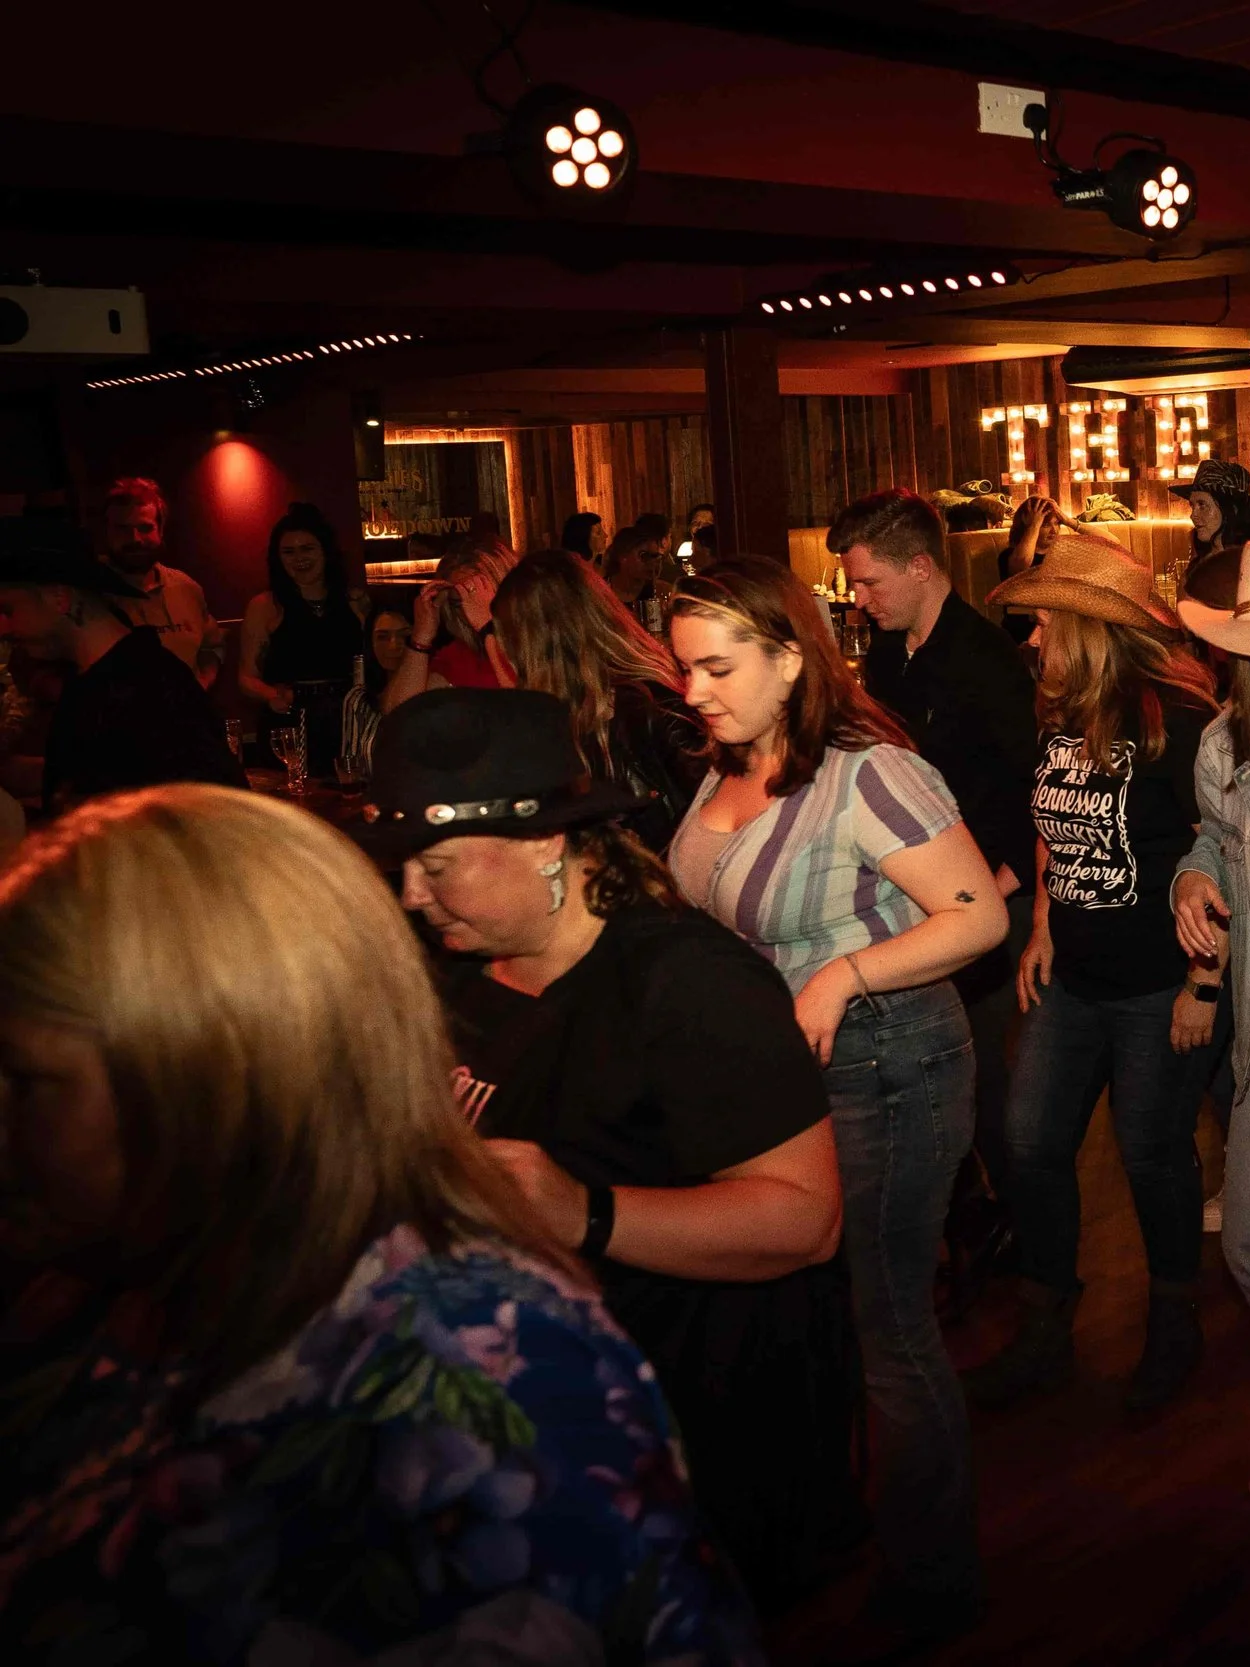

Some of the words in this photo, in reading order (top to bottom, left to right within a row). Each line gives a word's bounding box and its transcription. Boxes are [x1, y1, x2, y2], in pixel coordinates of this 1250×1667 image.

[981, 392, 1212, 485] THE
[1062, 769, 1090, 785] AS
[1031, 769, 1113, 818] Tennessee
[1049, 842, 1090, 856] WEET
[1047, 875, 1099, 902] Wine
